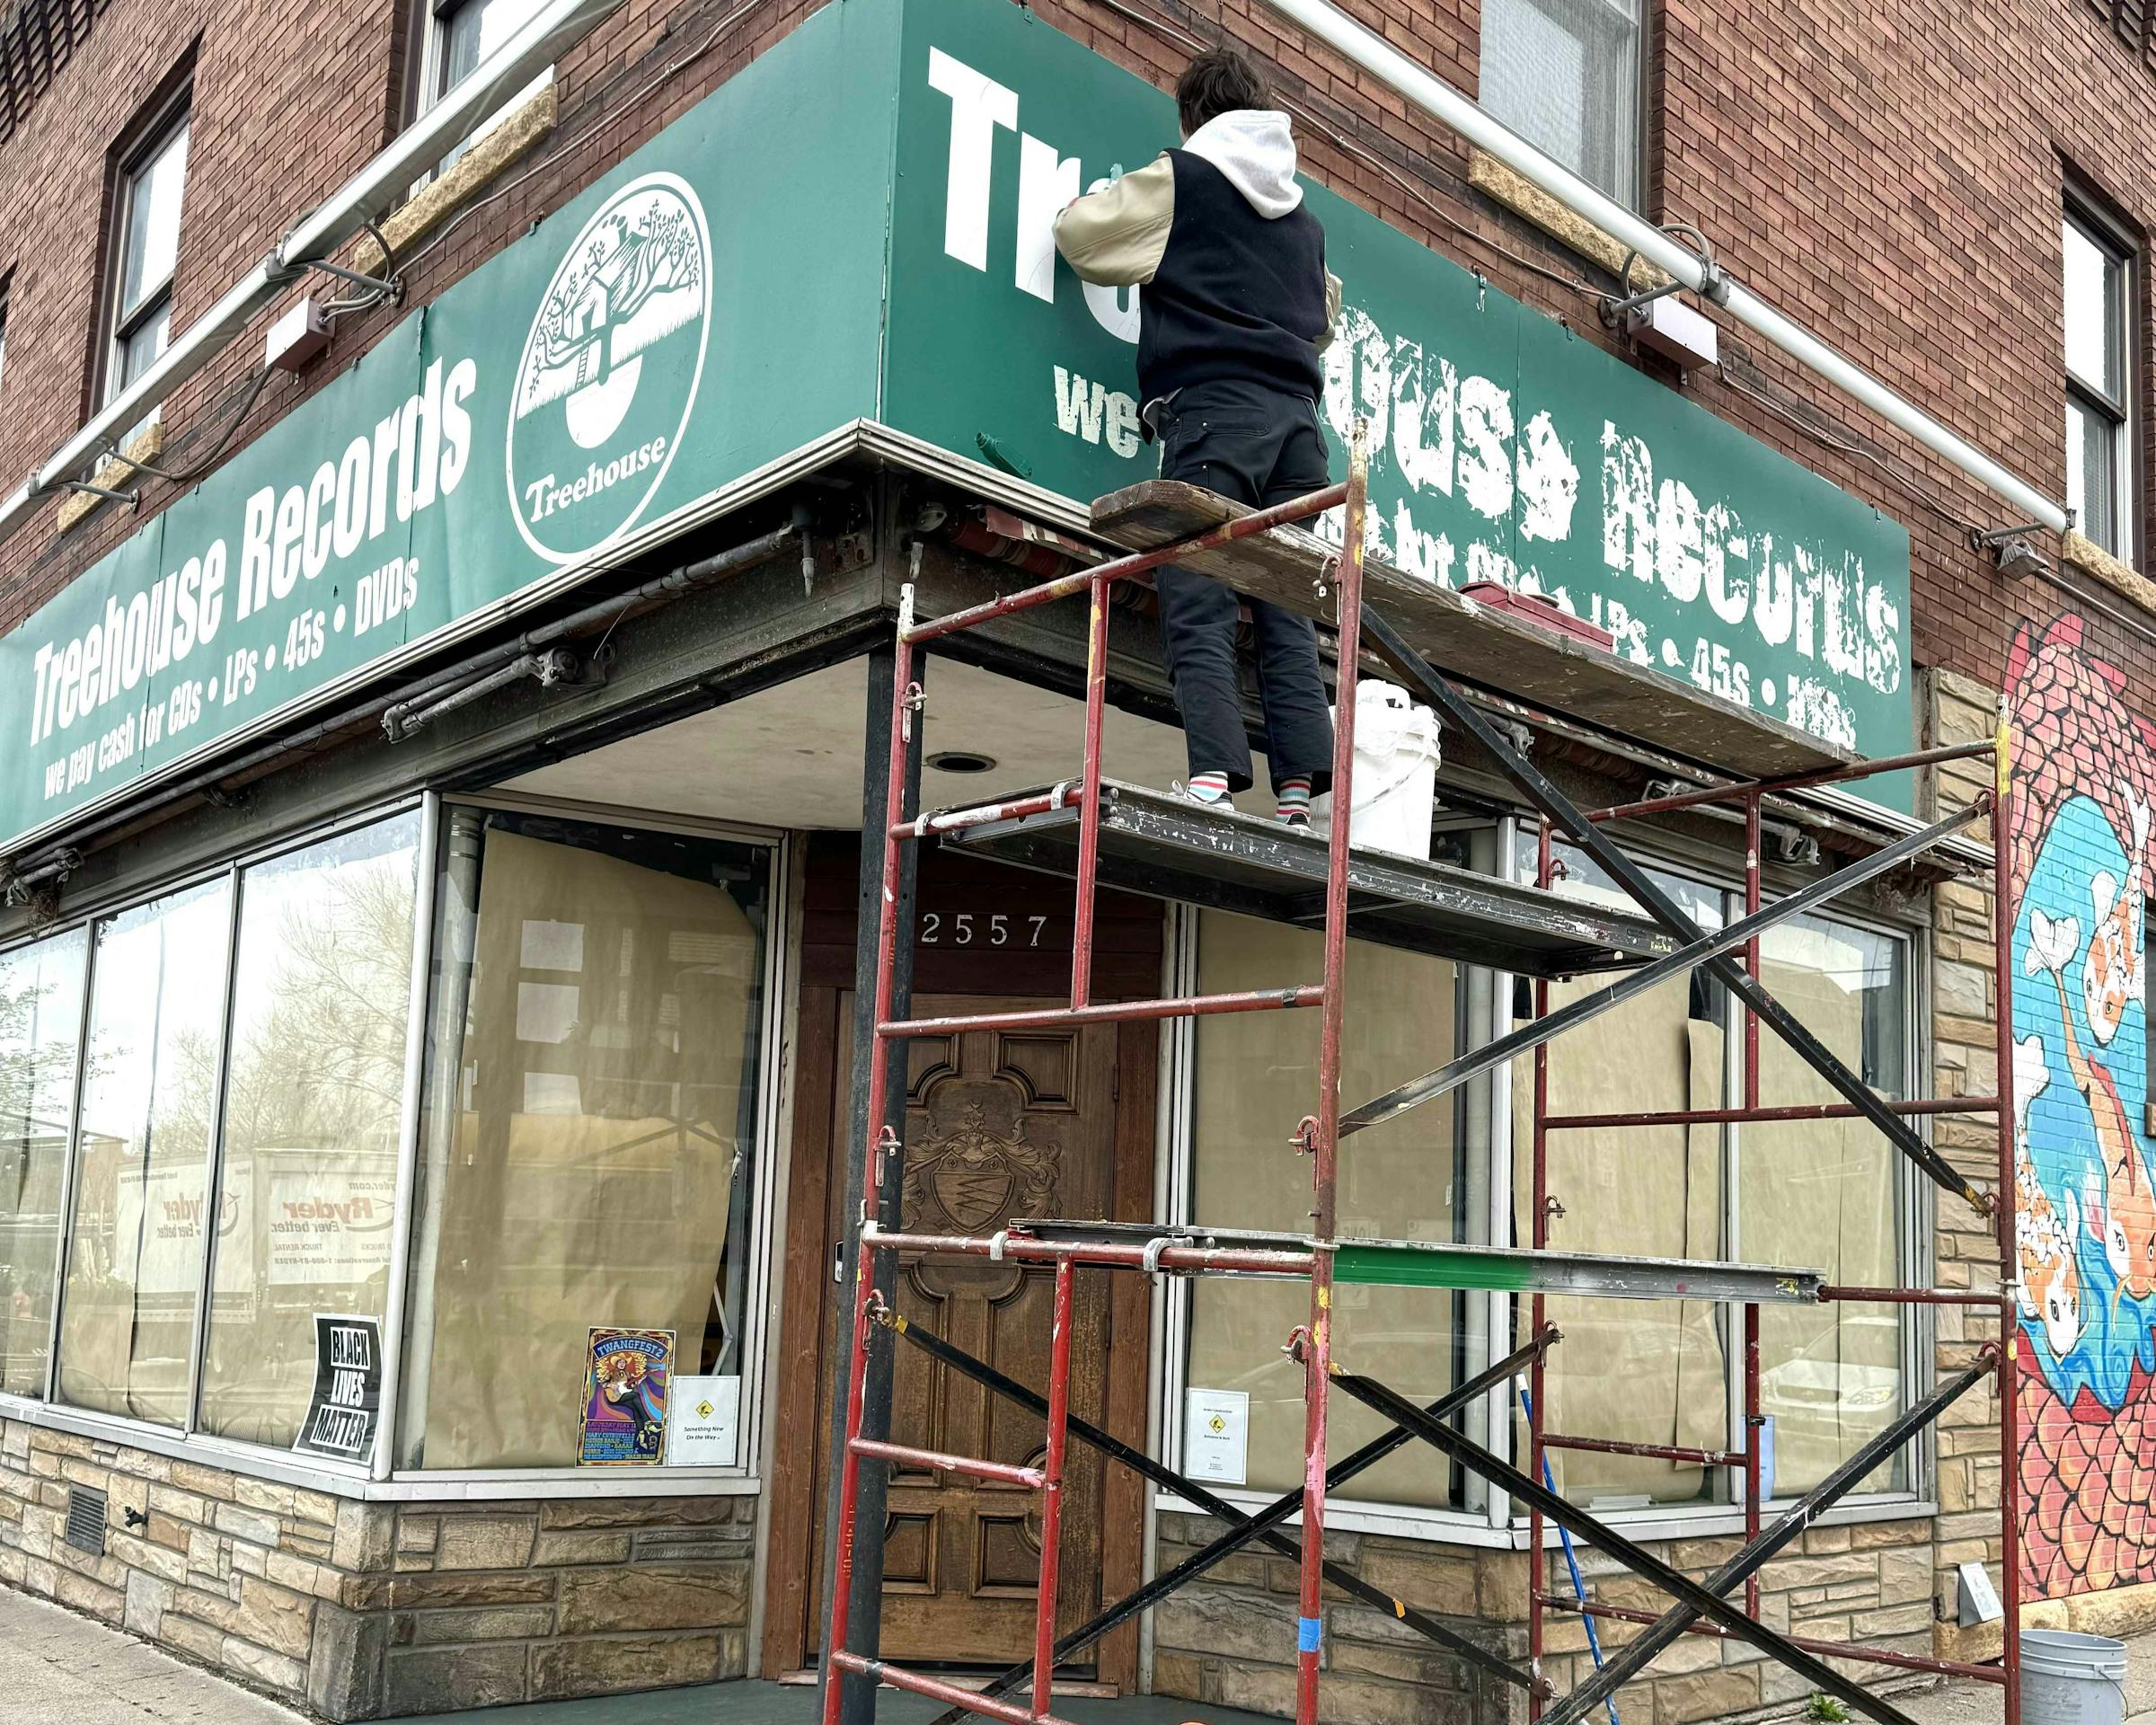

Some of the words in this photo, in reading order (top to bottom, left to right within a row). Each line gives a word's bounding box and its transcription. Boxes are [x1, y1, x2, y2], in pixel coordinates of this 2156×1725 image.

[526, 436, 666, 523] Treehouse
[31, 539, 227, 747] Treehouse
[237, 356, 477, 622] Records
[44, 756, 66, 801] we
[66, 740, 96, 793] pay
[98, 712, 135, 772] cash
[138, 701, 166, 751] for
[168, 680, 202, 736] CDs
[223, 648, 258, 707] LPs
[283, 608, 326, 672] 45s
[354, 556, 420, 637] DVDs
[921, 913, 1047, 946] 2557
[331, 1330, 369, 1367] BLACK
[597, 1340, 658, 1356] TWANGFEST
[655, 1348, 664, 1358] 2
[330, 1369, 366, 1408] LIVES
[313, 1407, 367, 1449] MATTER
